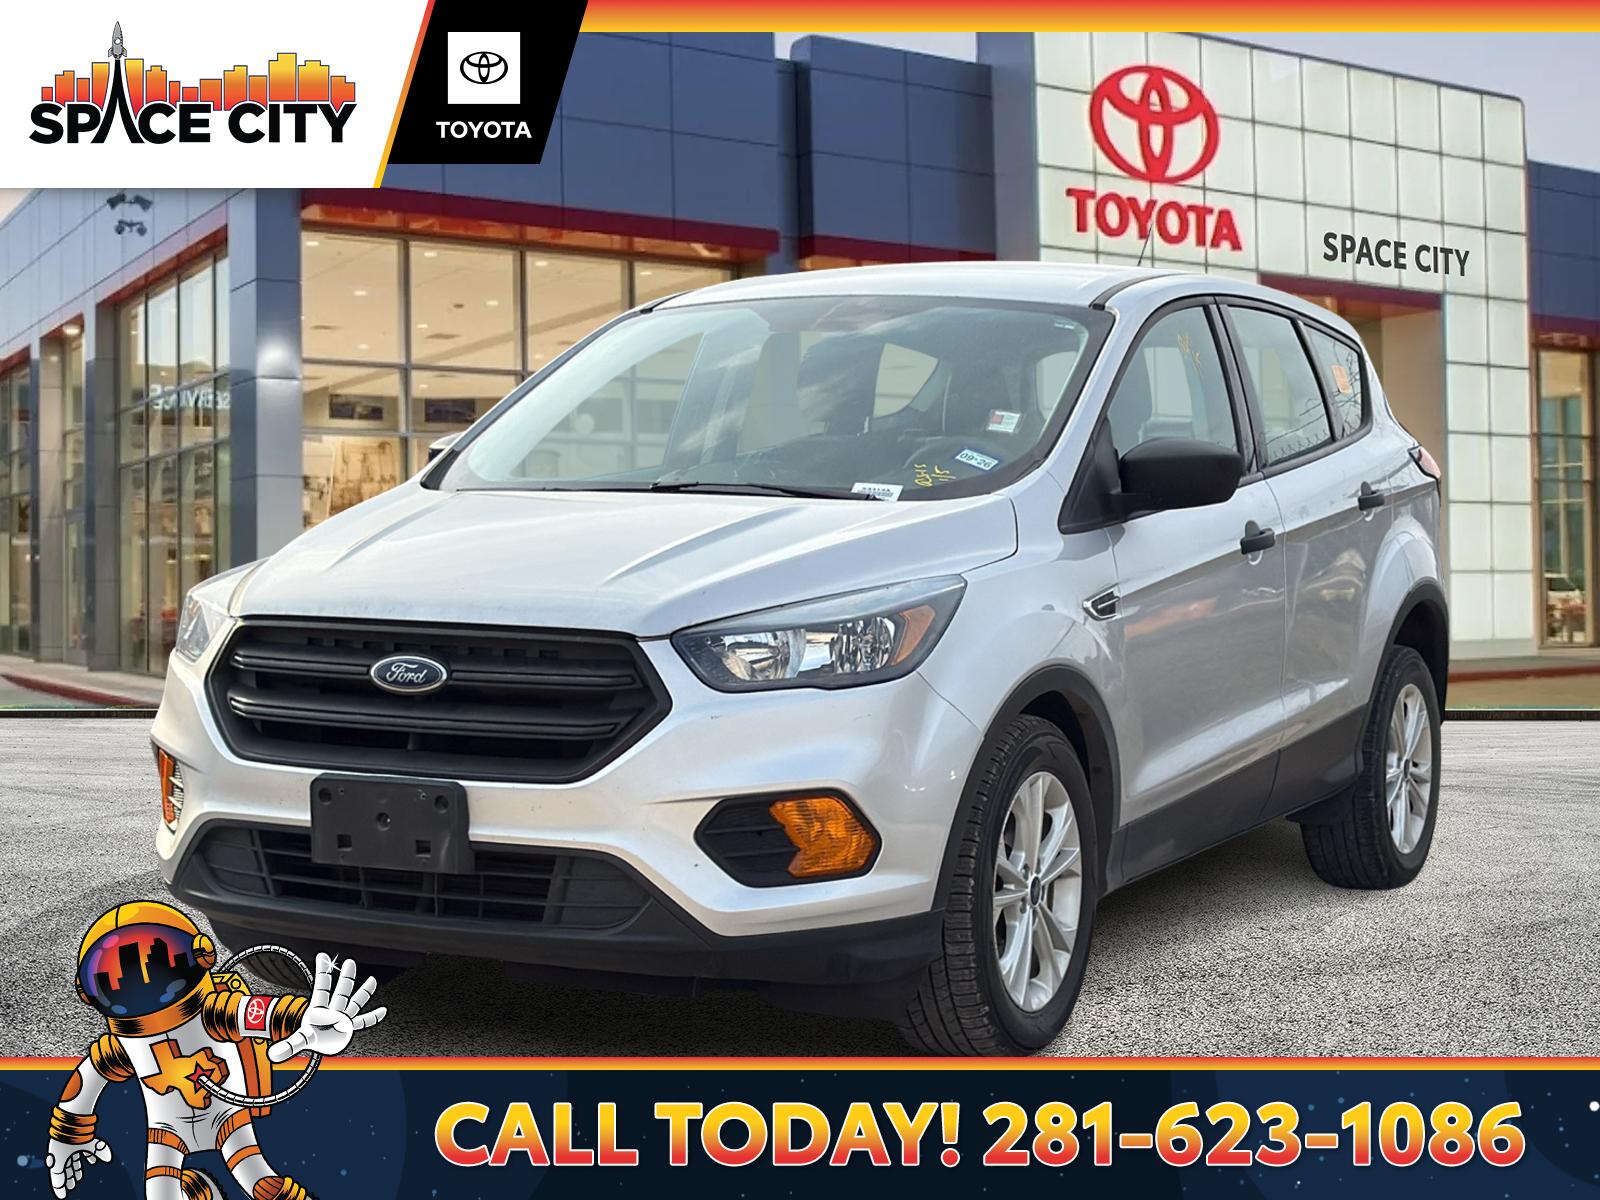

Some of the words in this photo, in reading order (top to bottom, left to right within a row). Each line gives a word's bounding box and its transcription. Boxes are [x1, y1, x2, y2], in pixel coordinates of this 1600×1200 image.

[1066, 188, 1242, 251] TOYOTA
[1322, 231, 1407, 270] SPACE
[1415, 245, 1470, 277] CITY
[386, 662, 427, 683] Ford
